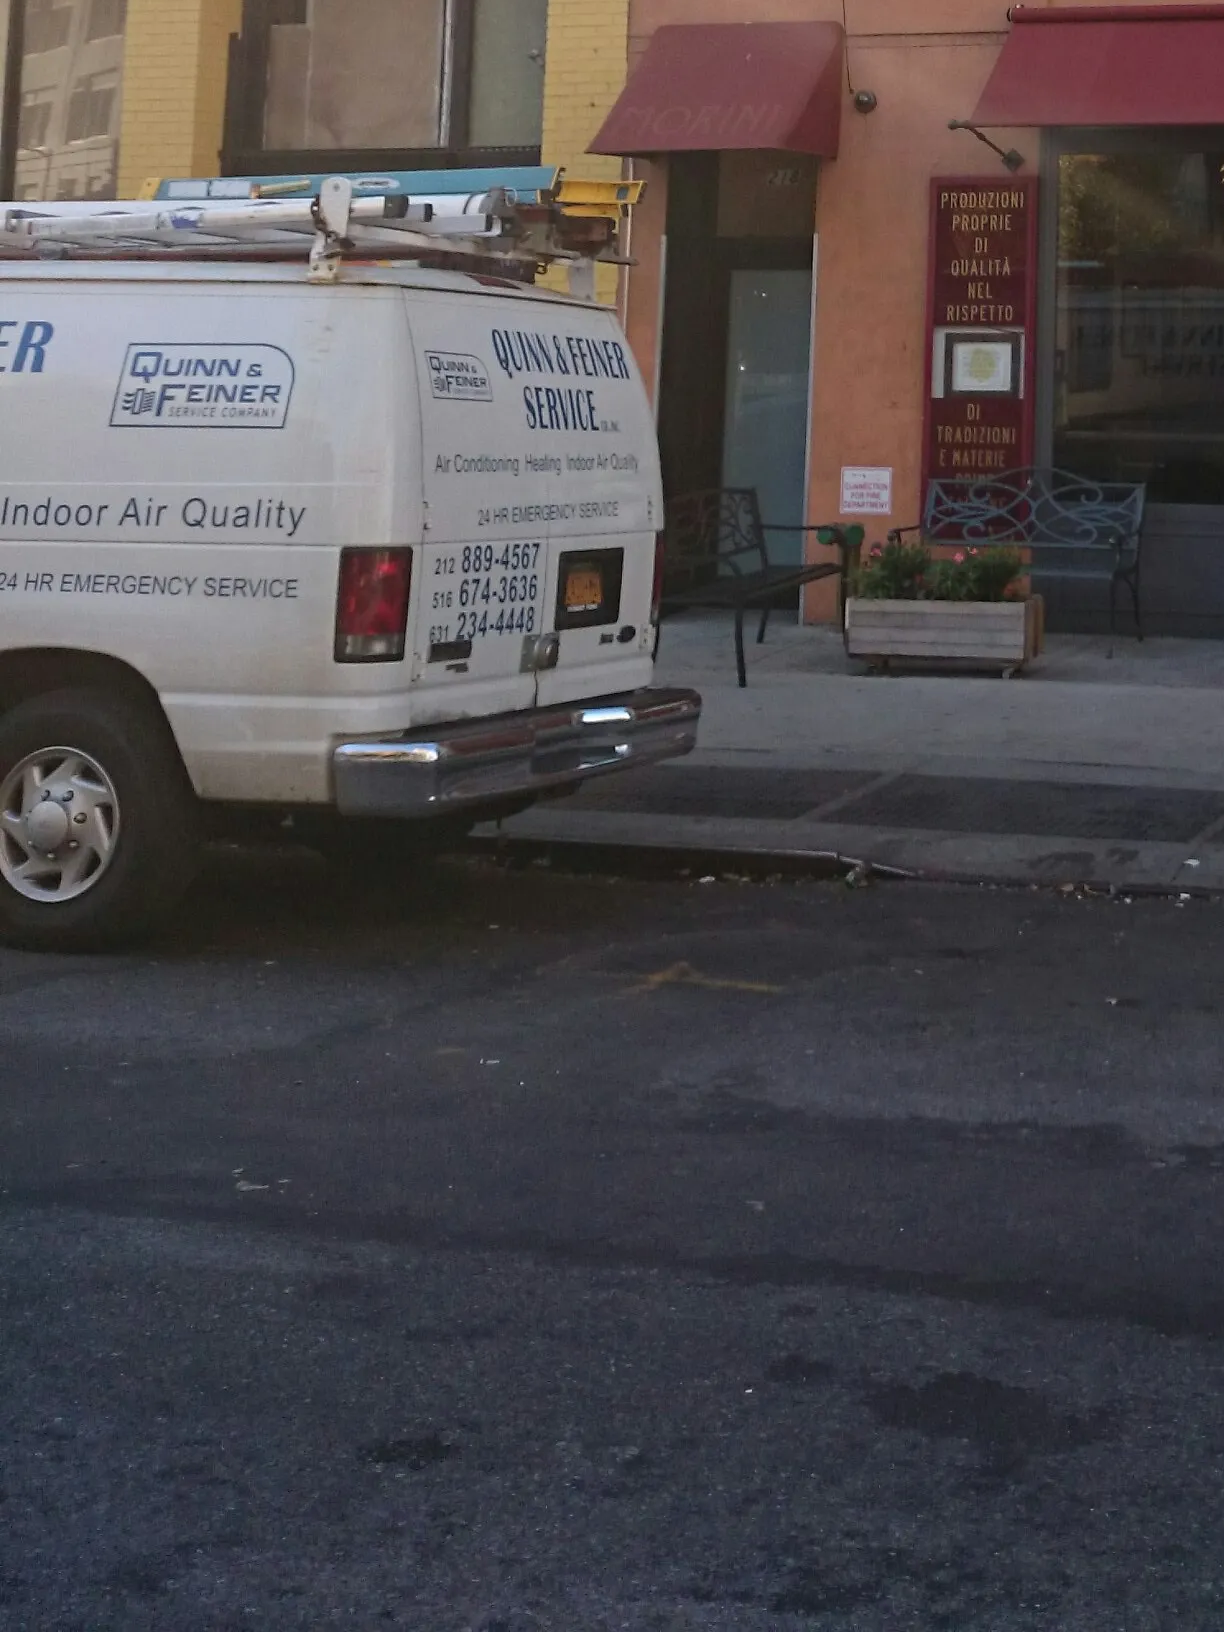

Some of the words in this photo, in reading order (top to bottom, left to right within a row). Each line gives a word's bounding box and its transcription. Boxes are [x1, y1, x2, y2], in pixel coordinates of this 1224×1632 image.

[941, 191, 1025, 209] PRODUZIONI
[952, 214, 1012, 231] PROPRIE
[975, 236, 988, 253] DI
[951, 257, 1011, 276] QUALITÀ
[967, 282, 993, 299] NEL
[946, 304, 1014, 321] RISPETTO
[492, 328, 554, 380] QUINN
[552, 334, 571, 375] &
[565, 336, 631, 380] FEINER
[130, 351, 241, 384] QUINN
[246, 363, 263, 377] &
[429, 356, 469, 374] QUINN
[445, 375, 487, 393] FEINER
[155, 384, 282, 417] FEINER
[523, 385, 600, 432] SERVICE
[167, 406, 216, 417] SERVICE
[221, 407, 277, 418] COMPANY
[967, 403, 980, 421] DI
[937, 425, 1016, 444] TRADIZIONI
[435, 453, 451, 473] Air
[453, 454, 520, 476] Conditioning
[524, 453, 562, 476] Heating
[939, 449, 947, 467] E
[952, 449, 1006, 467] MATERIE
[0, 496, 109, 527] Indoor
[118, 497, 167, 527] Air
[181, 497, 307, 537] Quality
[493, 507, 508, 524] HR
[512, 504, 577, 523] EMERGENCY
[579, 501, 619, 519] SERVICE
[435, 557, 456, 575] 212
[461, 542, 540, 574] 889-4567
[24, 572, 54, 593] HR
[60, 573, 198, 597] EMERGENCY
[204, 576, 299, 599] SERVICE
[459, 574, 538, 607] 674-3636
[457, 606, 535, 640] 234-4448
